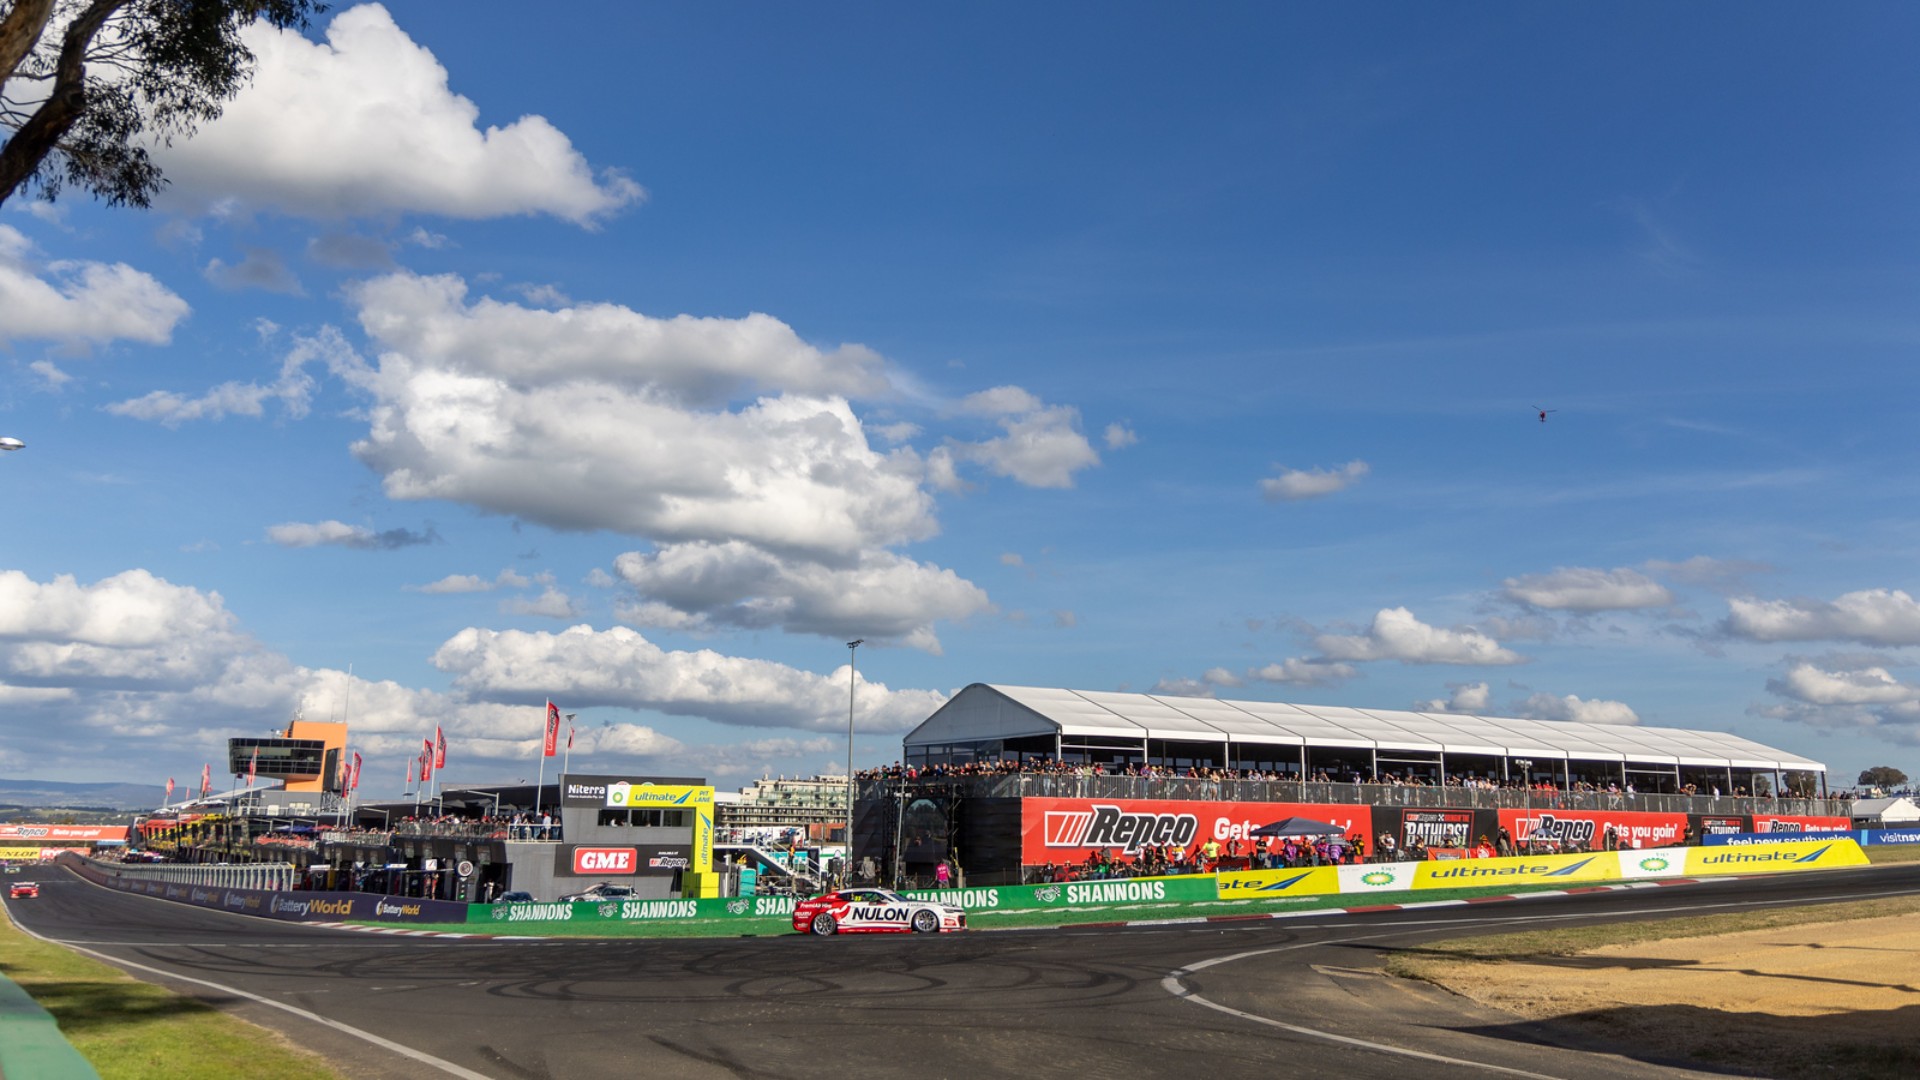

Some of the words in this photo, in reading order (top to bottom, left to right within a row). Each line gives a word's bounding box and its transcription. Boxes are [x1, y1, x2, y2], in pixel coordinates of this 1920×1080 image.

[568, 784, 606, 795] Niterra
[635, 792, 677, 801] ultimate
[1082, 804, 1198, 855] Repco
[1539, 814, 1596, 844] Repco
[1603, 821, 1629, 837] Gts
[1632, 826, 1651, 841] you
[581, 852, 630, 870] GME
[1703, 852, 1797, 864] ultimate
[1431, 865, 1549, 878] ultimate
[1067, 881, 1165, 904] SHANNONS
[509, 904, 573, 921] SHANNONS
[622, 900, 697, 919] SHANNONS
[755, 898, 797, 915] SHAN
[852, 907, 910, 921] NULON
